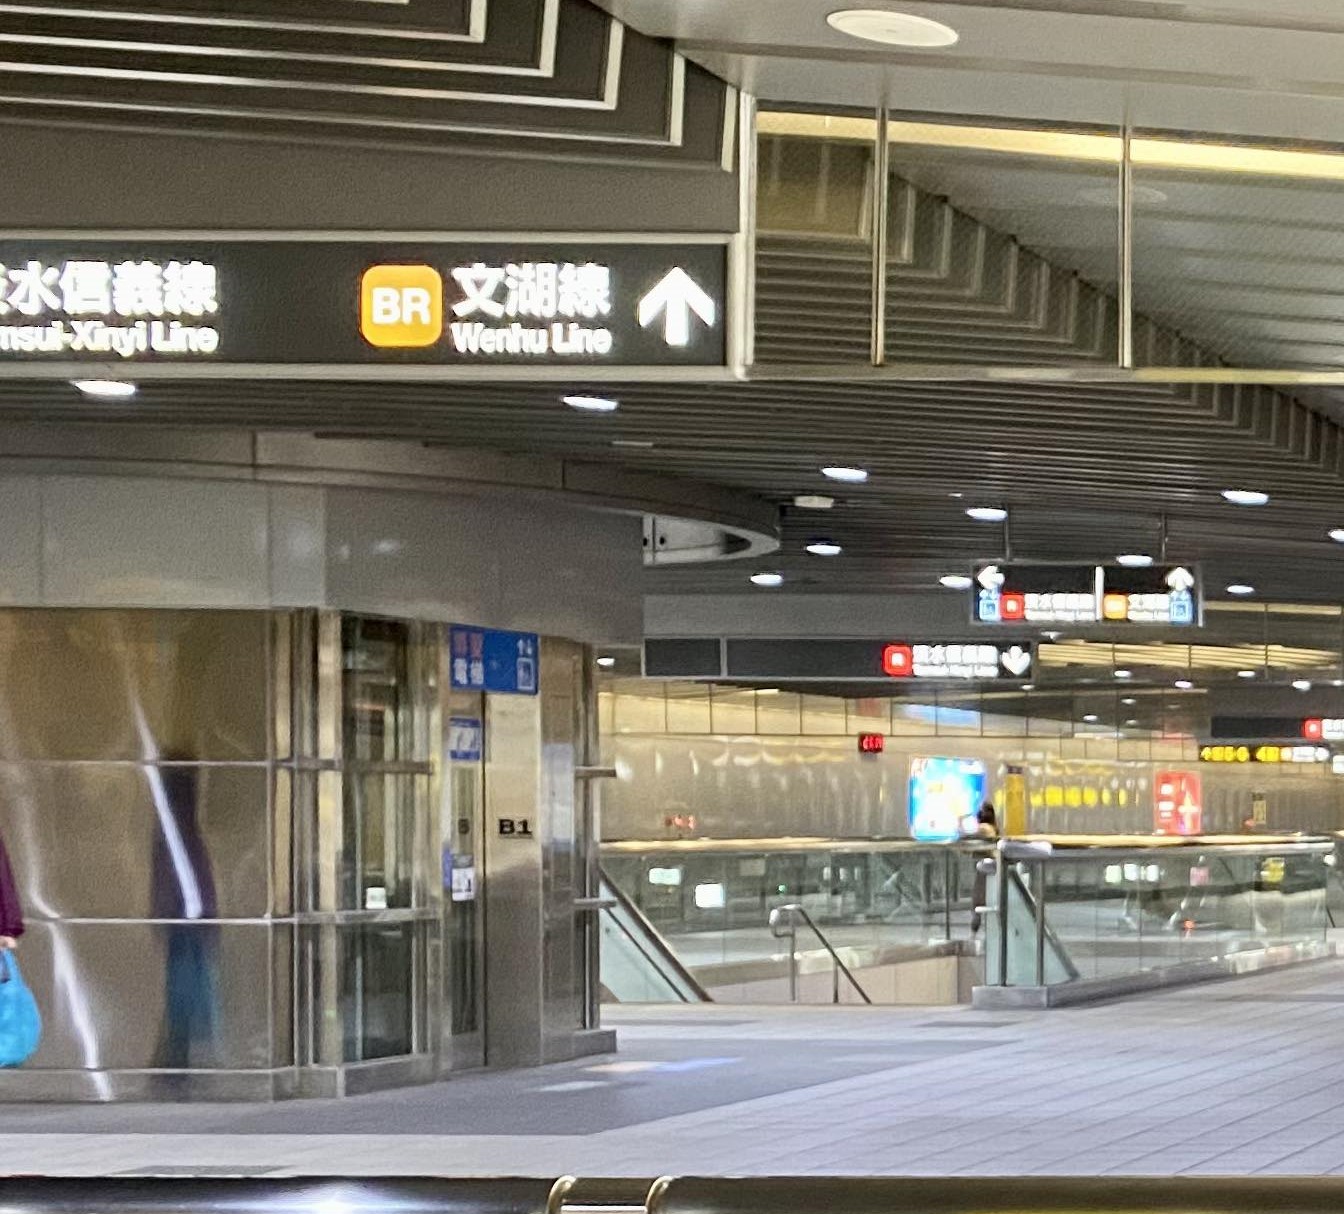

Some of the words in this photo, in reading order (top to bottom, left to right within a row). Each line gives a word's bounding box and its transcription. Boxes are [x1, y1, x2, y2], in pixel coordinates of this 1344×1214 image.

[0, 260, 218, 316] 水信義線
[452, 262, 611, 318] 文湖線
[372, 287, 431, 325] BR
[151, 320, 219, 352] Line
[450, 322, 549, 354] Wenhu
[551, 322, 613, 354] Line
[499, 818, 533, 836] B1
